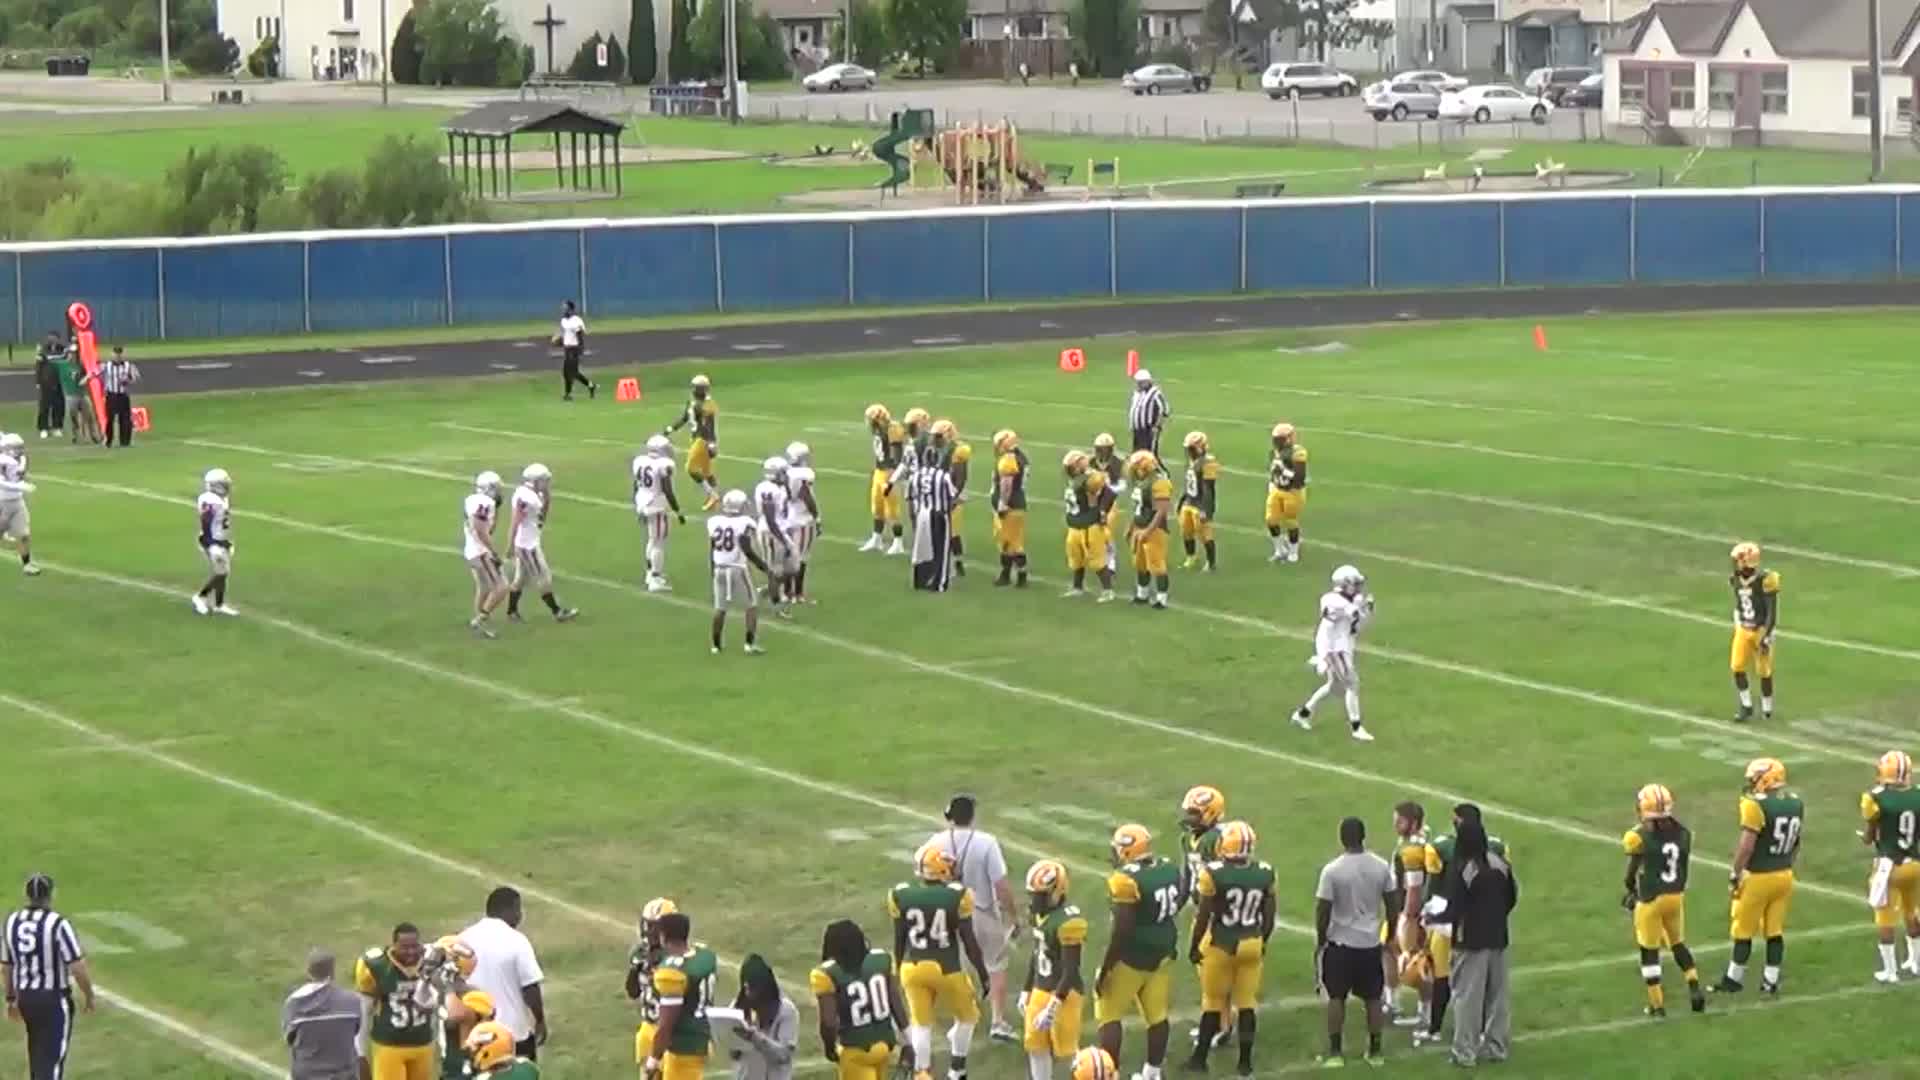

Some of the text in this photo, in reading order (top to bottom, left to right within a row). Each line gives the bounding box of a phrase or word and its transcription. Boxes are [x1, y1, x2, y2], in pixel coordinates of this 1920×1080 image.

[713, 527, 735, 552] 28
[1769, 815, 1801, 855] 50
[1898, 810, 1916, 850] 9
[1660, 841, 1680, 883] 3
[1221, 887, 1264, 926] 30
[17, 920, 39, 953] S
[905, 908, 950, 950] 24
[847, 973, 891, 1027] 20
